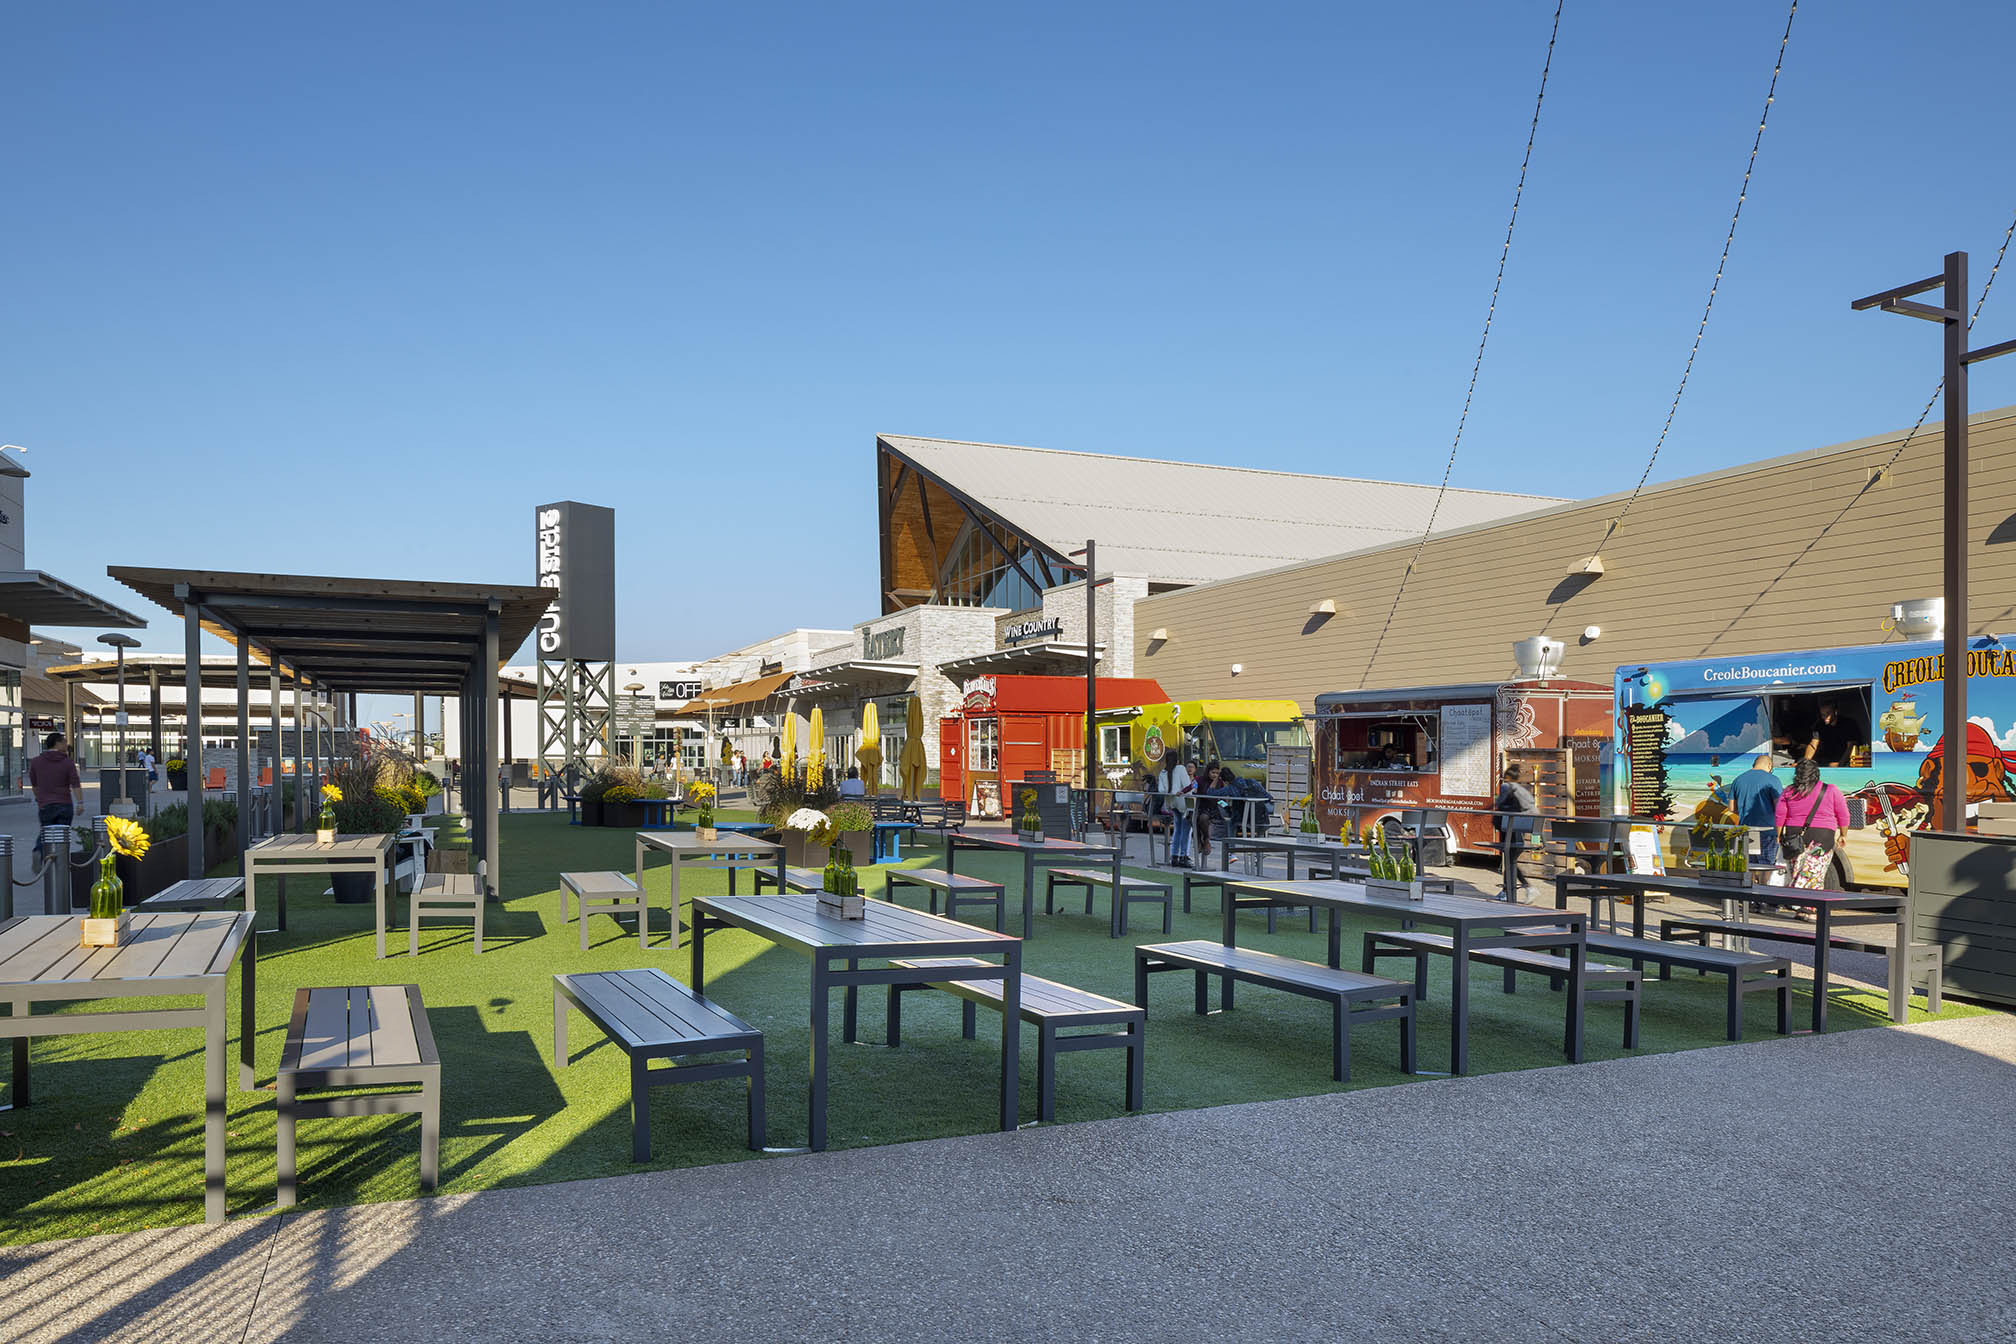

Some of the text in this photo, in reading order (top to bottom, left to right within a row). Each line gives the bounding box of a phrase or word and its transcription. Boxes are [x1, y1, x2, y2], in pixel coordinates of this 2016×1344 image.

[1004, 617, 1057, 638] WINE COUNTRY
[1703, 663, 1837, 681] CreoleBoucanier.com
[676, 683, 702, 698] OFF
